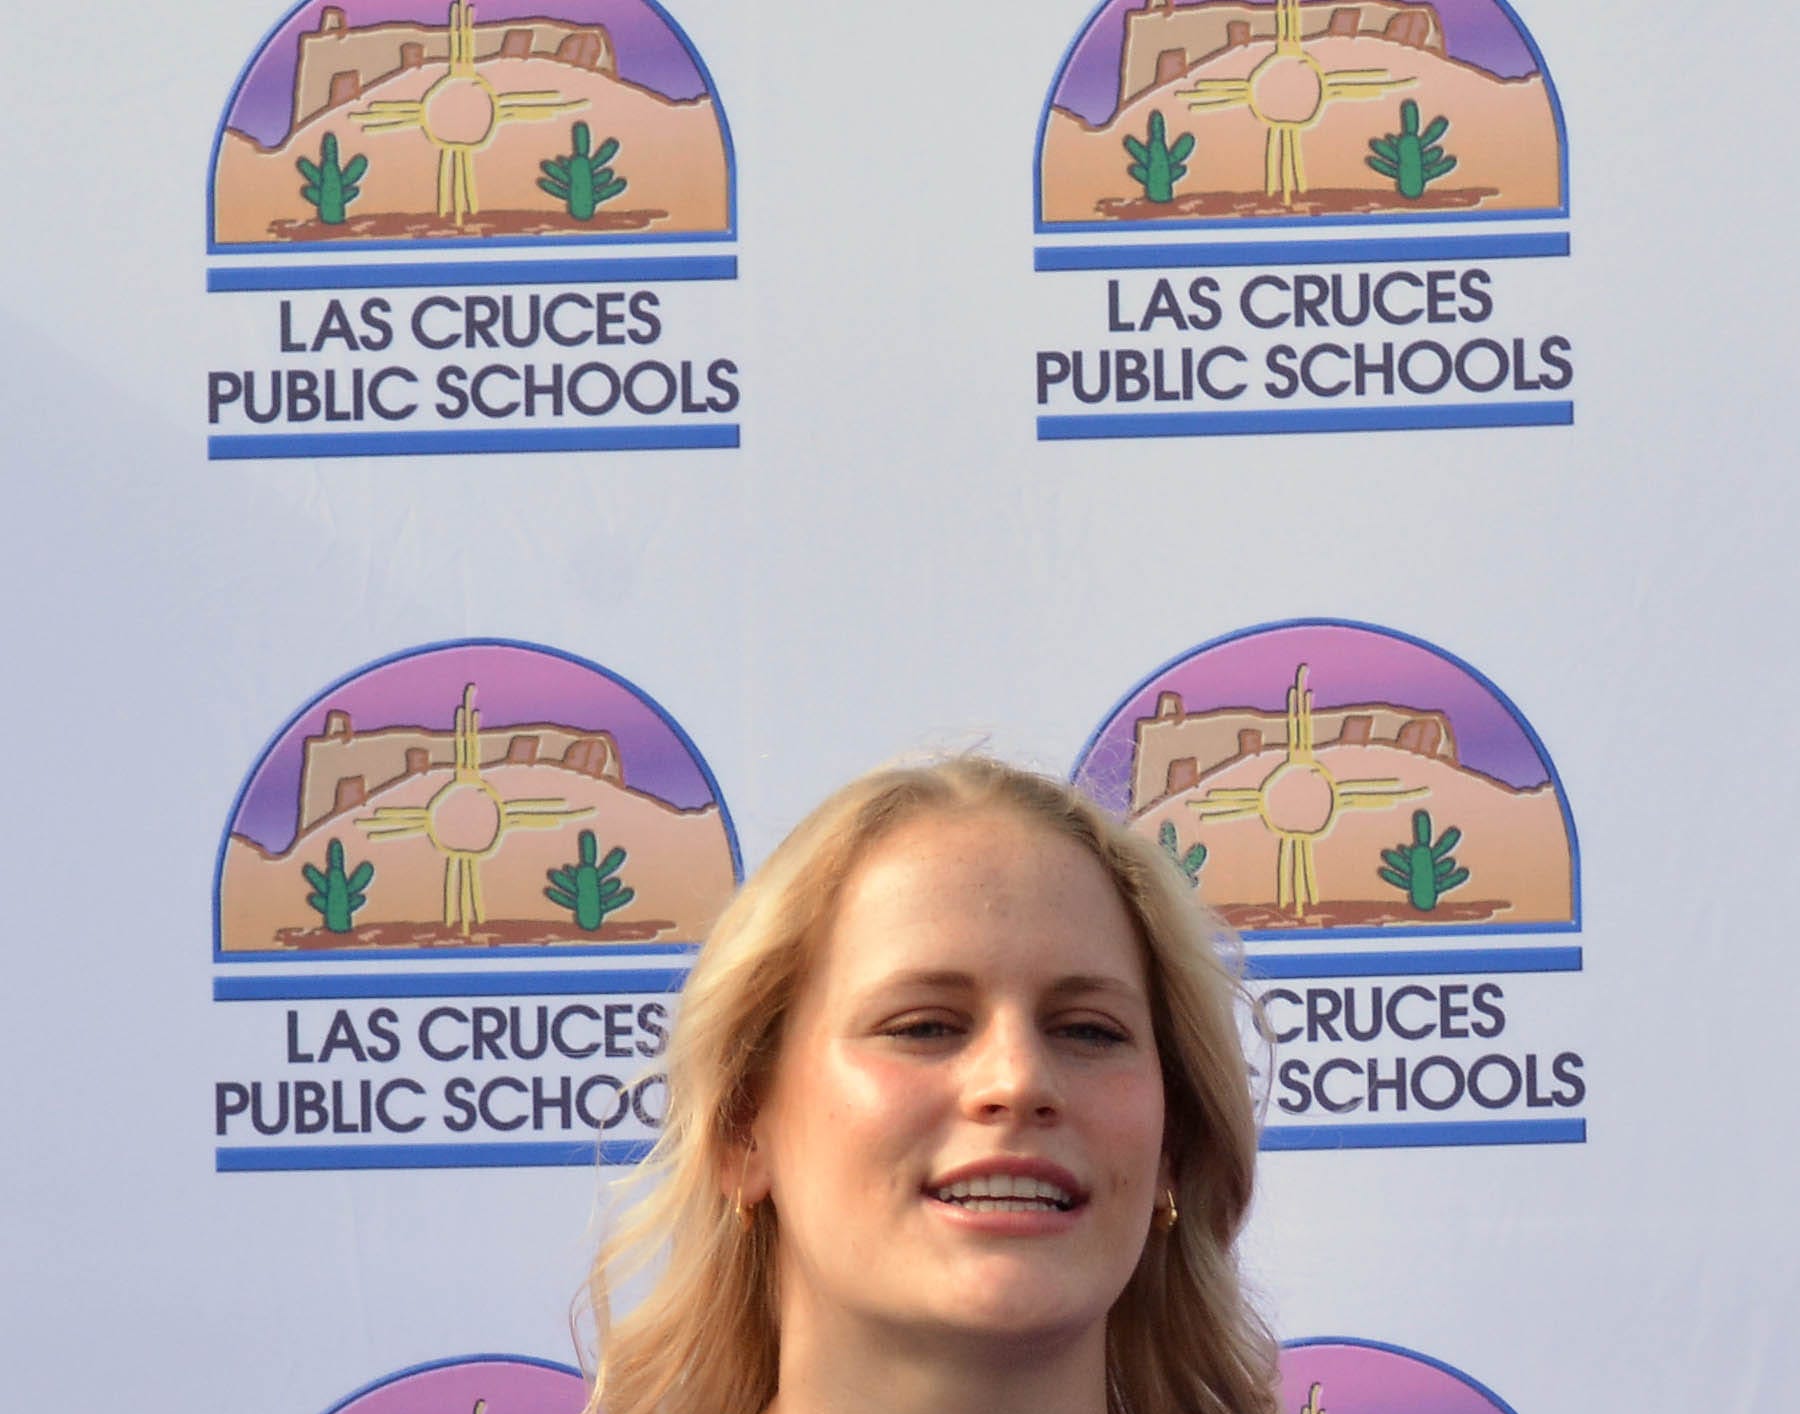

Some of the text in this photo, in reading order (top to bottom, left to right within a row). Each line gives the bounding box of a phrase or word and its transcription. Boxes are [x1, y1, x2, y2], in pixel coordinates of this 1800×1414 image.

[281, 291, 661, 352] LAS CRUCES
[1109, 269, 1492, 331] LAS CRUCES
[209, 359, 739, 423] PUBLIC SCHOOLS
[1037, 336, 1572, 404] PUBLIC SCHOOLS
[288, 1003, 664, 1063] LAS CRUCES
[1253, 983, 1505, 1043] CRUCES
[216, 1075, 663, 1135] PUBLIC SCHOO
[1278, 1052, 1585, 1112] SCHOOLS
